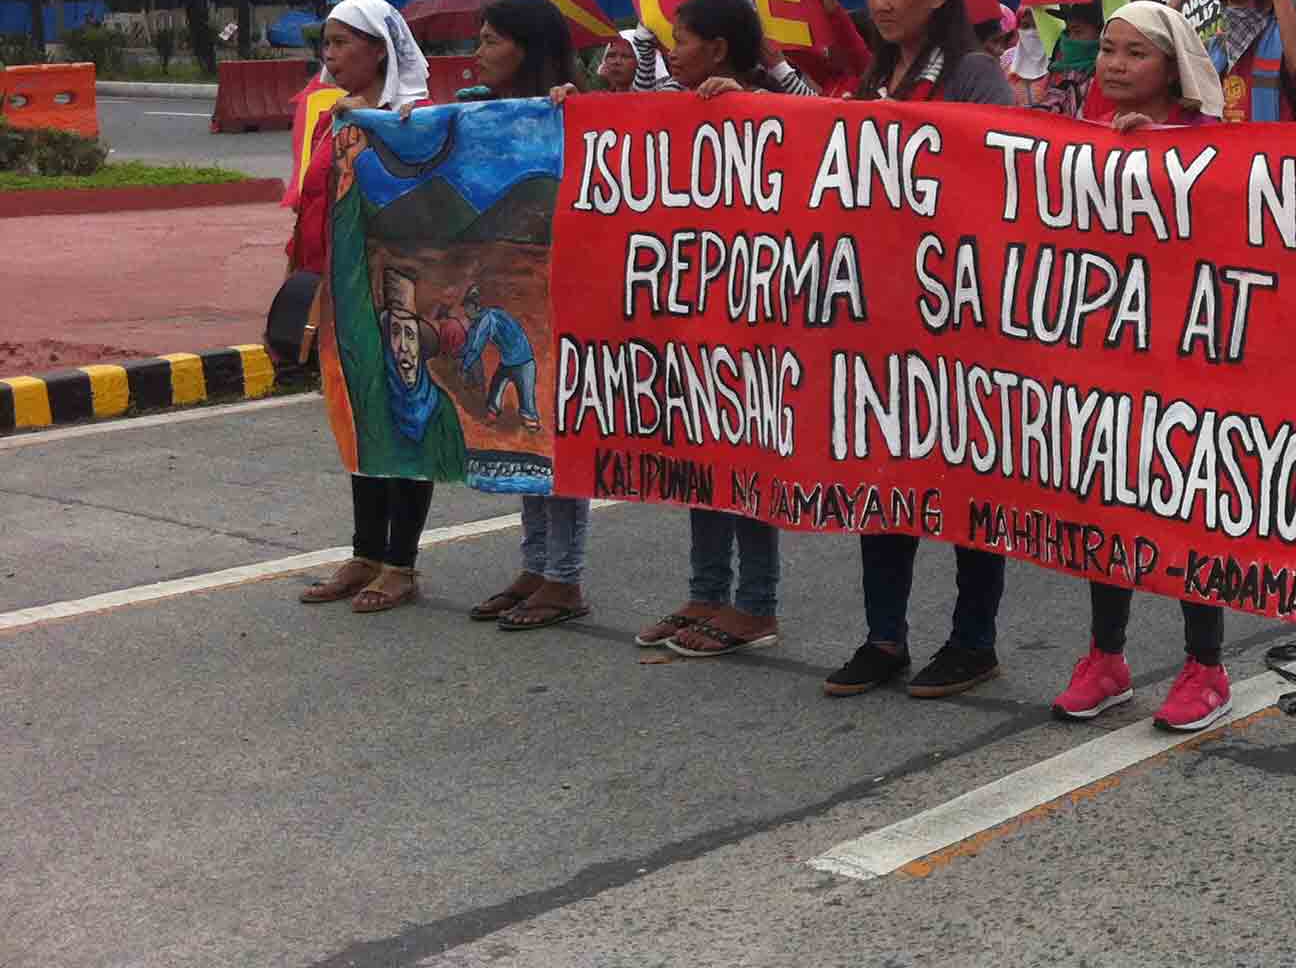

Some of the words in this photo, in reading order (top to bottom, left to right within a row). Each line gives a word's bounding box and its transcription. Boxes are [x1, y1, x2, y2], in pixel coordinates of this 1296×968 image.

[572, 118, 784, 215] ISULONG
[808, 118, 942, 217] ANG
[985, 131, 1217, 240] TUNAY
[624, 231, 867, 324] REPORMA
[914, 231, 985, 330] SA
[999, 244, 1150, 351] LUPA
[1180, 262, 1275, 360] AT
[556, 335, 802, 457] PAMBANSANG
[731, 469, 760, 515] NG
[768, 478, 942, 532] DAMAYANG
[968, 498, 1159, 585] MAHIHIRAP
